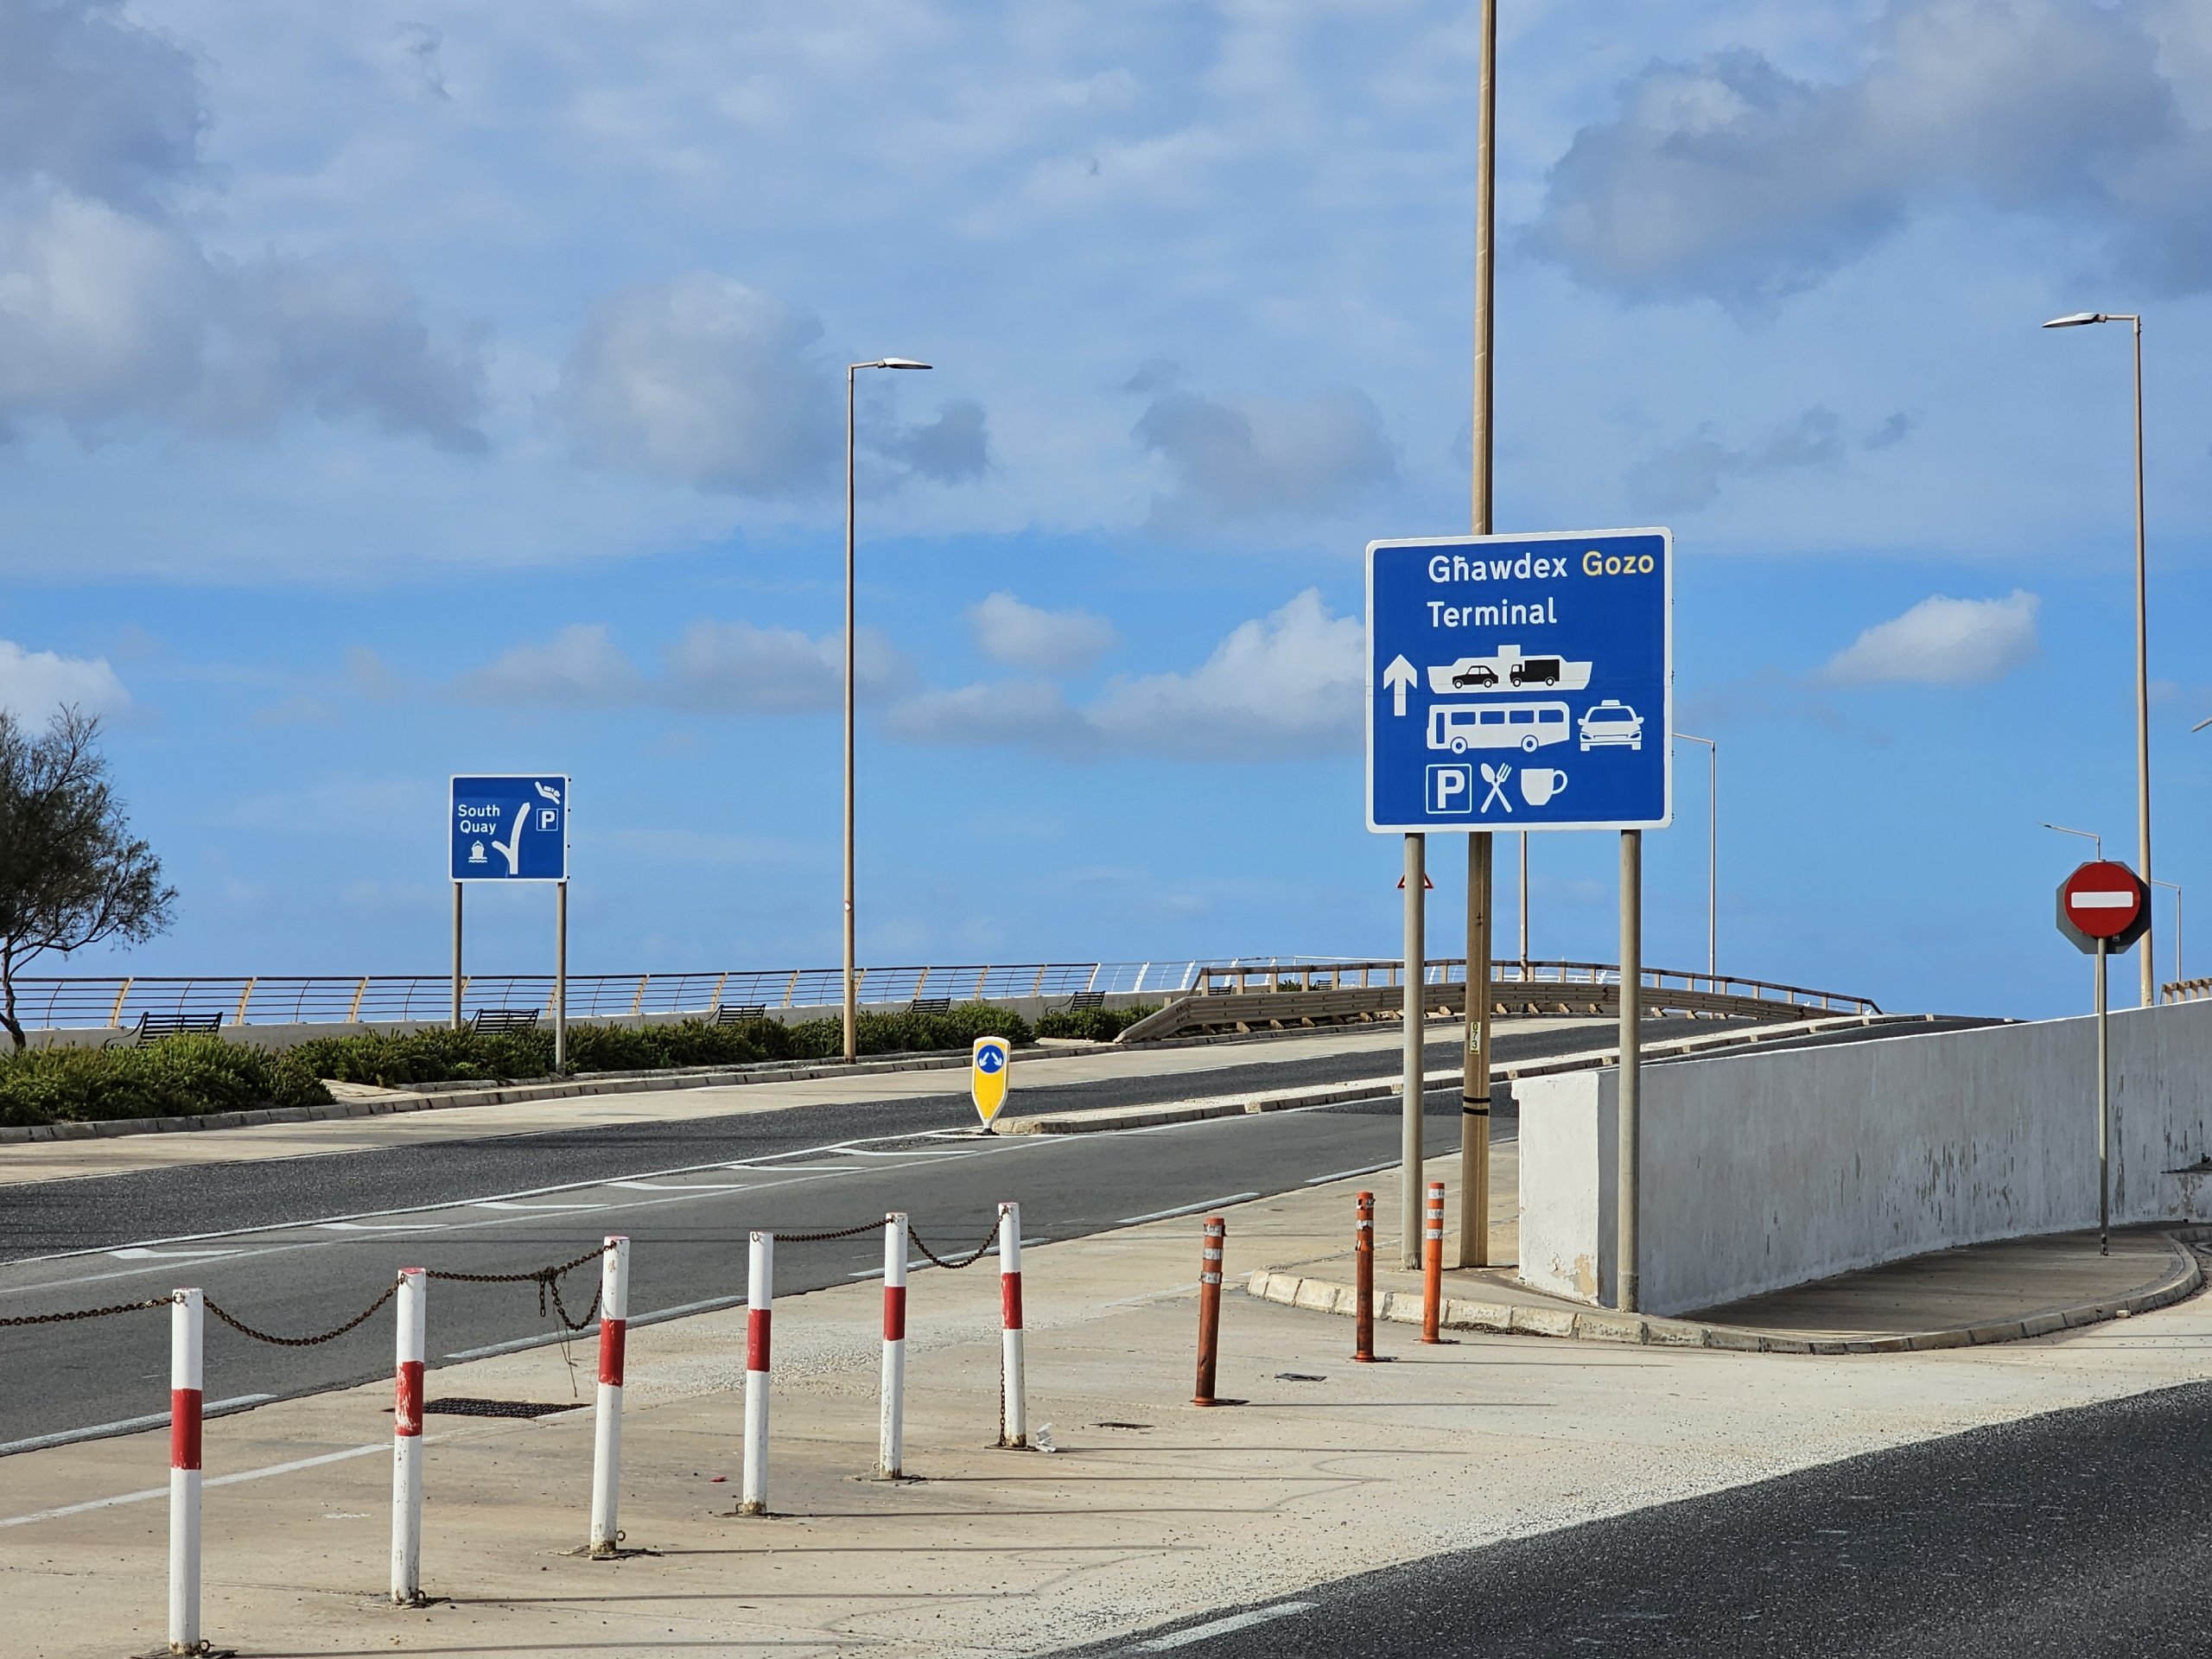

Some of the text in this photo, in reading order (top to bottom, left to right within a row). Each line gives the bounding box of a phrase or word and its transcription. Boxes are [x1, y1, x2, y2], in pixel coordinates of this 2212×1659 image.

[1582, 550, 1654, 576] Gozo
[1427, 596, 1557, 627] Terminal
[1437, 769, 1465, 810] P
[458, 804, 500, 817] South
[541, 810, 556, 829] P
[460, 820, 496, 835] Quay
